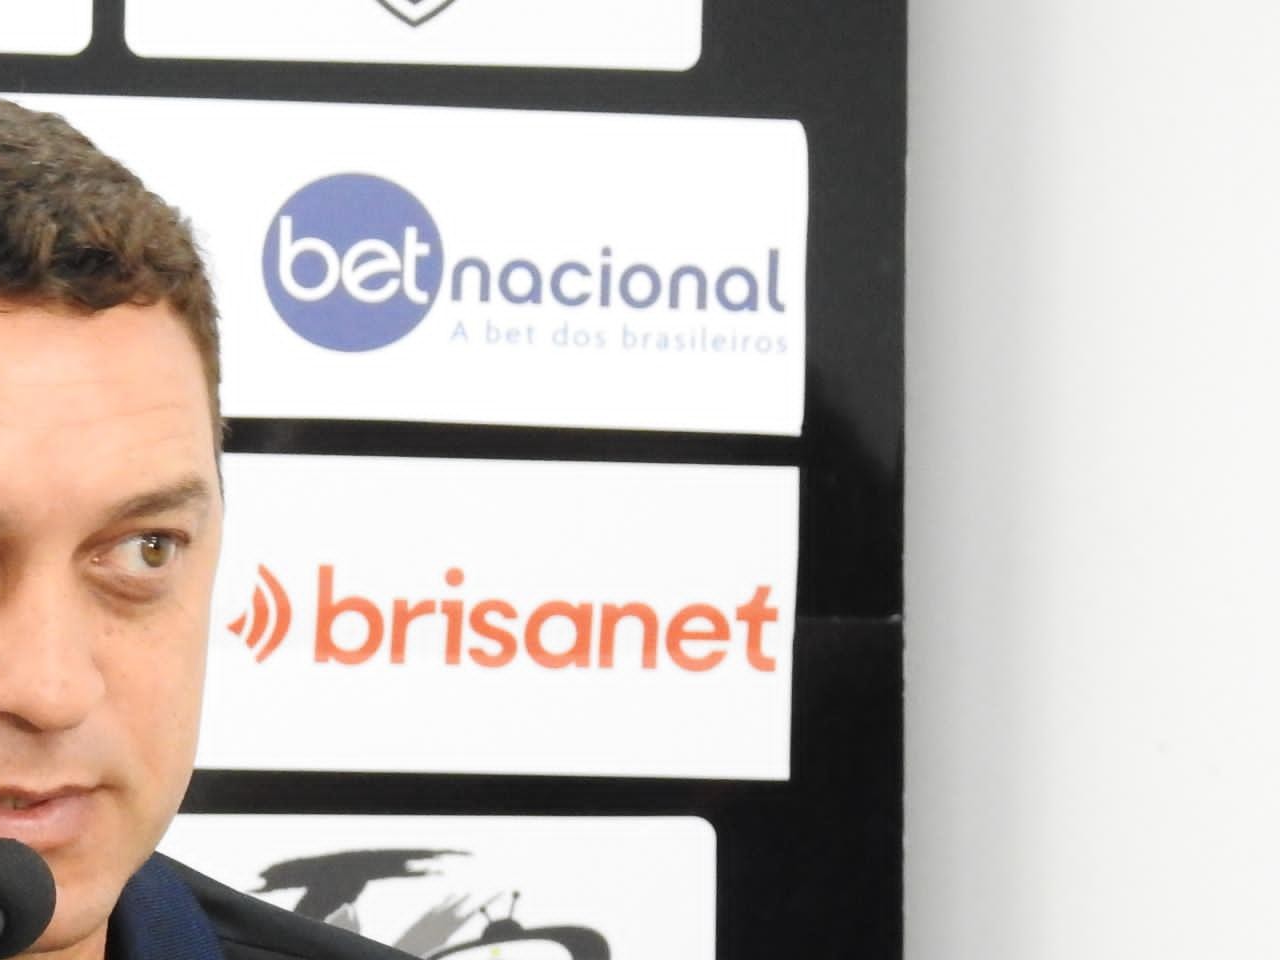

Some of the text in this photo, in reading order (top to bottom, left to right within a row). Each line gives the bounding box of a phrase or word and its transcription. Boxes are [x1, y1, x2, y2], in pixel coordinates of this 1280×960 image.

[278, 214, 785, 312] bet nacional
[449, 319, 789, 355] A bet dos brasileiros
[314, 564, 779, 673] brisanet
